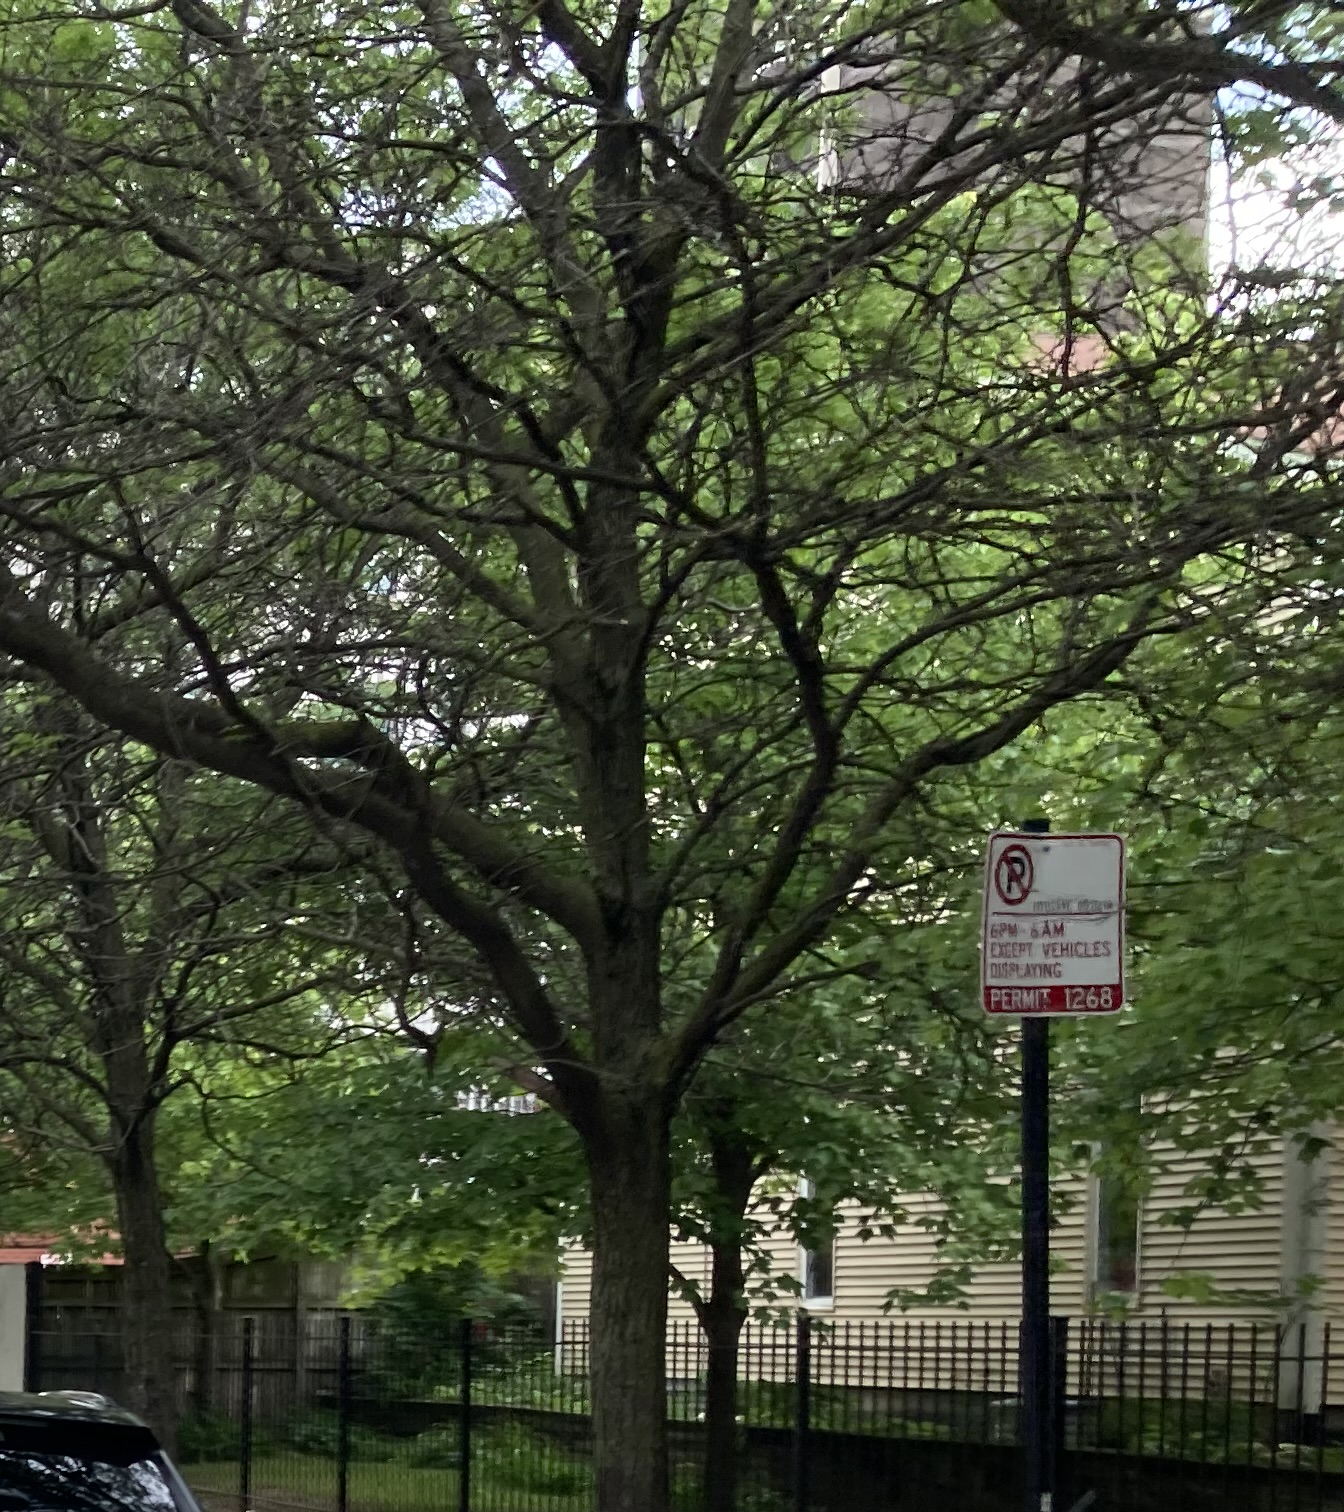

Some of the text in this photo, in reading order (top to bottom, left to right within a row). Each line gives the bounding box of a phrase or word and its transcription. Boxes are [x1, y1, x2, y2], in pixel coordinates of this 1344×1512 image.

[991, 940, 1111, 958] EXCEPT VEHICLES
[991, 962, 1062, 979] DISPLAYING
[990, 986, 1113, 1010] PERMIT 1268
